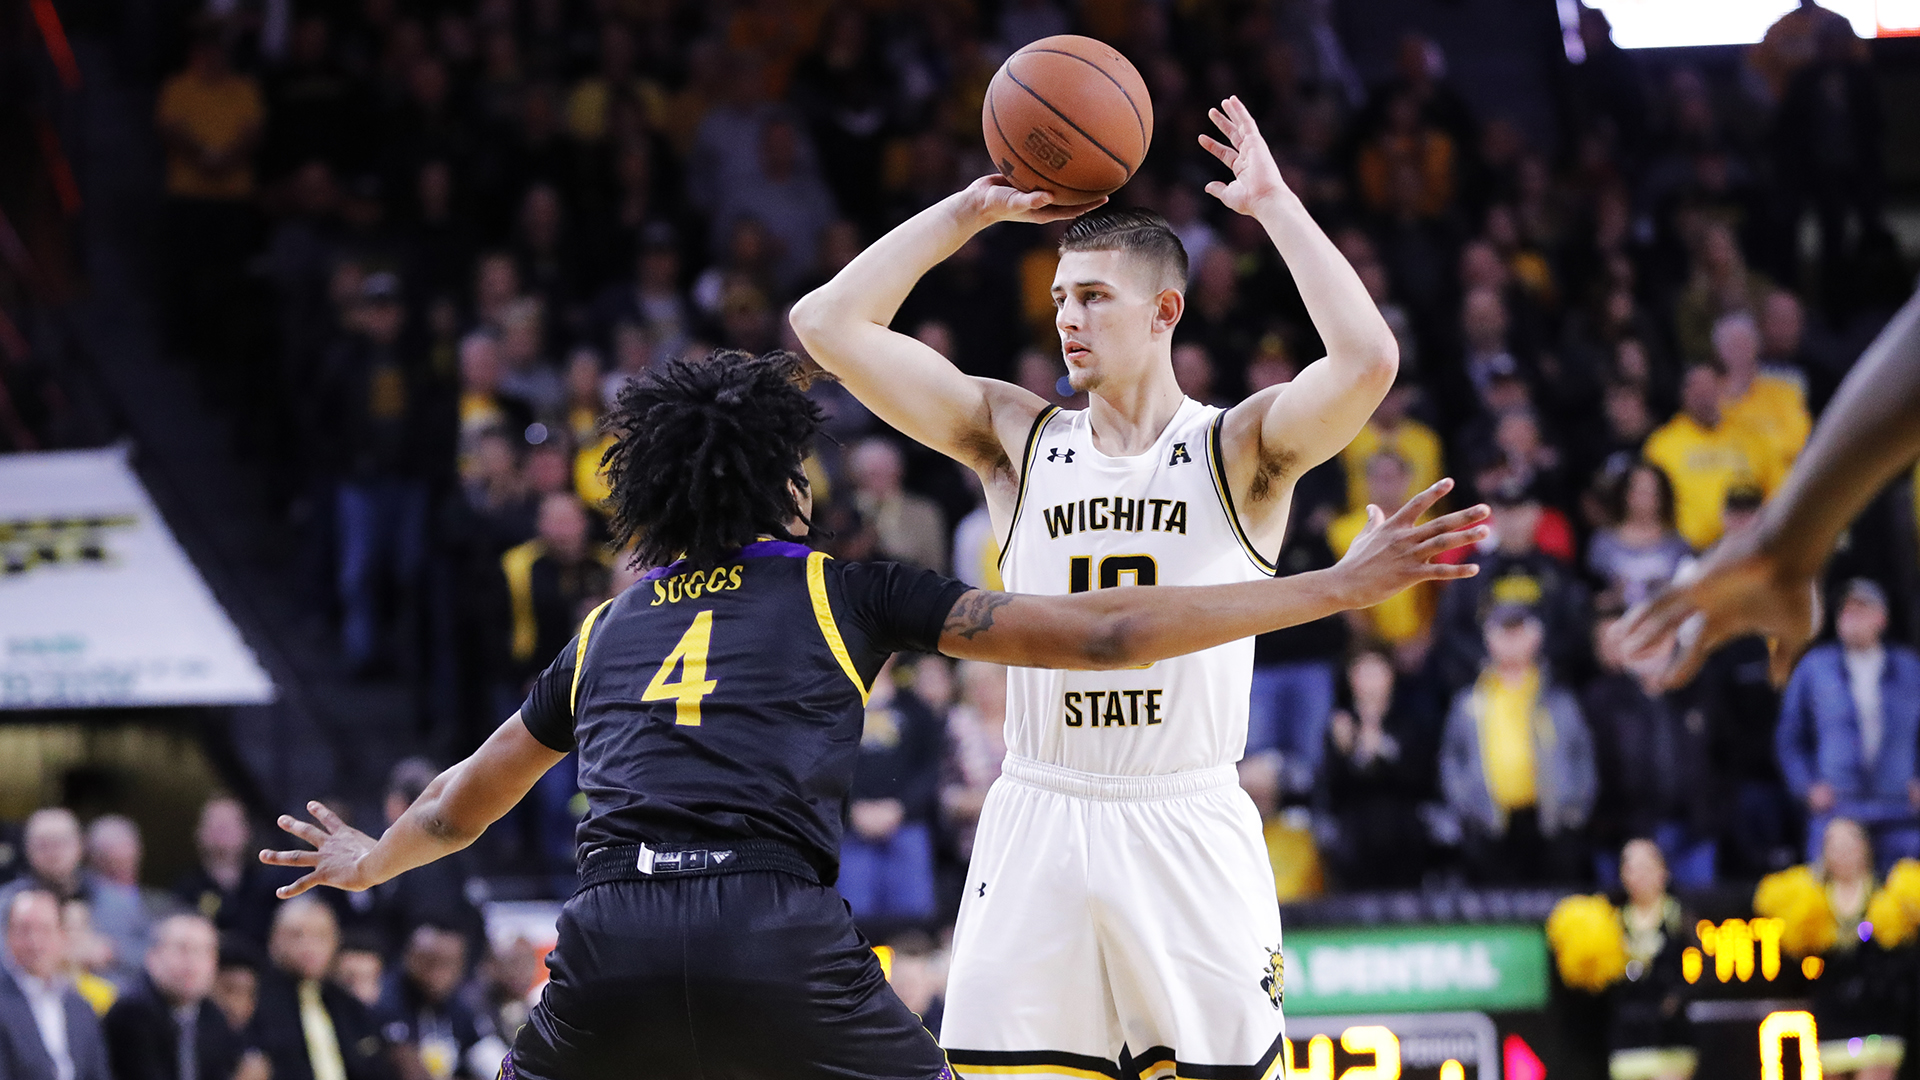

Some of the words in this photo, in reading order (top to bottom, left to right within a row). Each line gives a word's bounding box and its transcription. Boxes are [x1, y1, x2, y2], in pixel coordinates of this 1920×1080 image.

[1043, 496, 1187, 539] WICHITA
[650, 565, 744, 606] SUGGS
[640, 609, 718, 727] 4
[1064, 689, 1163, 728] STATE
